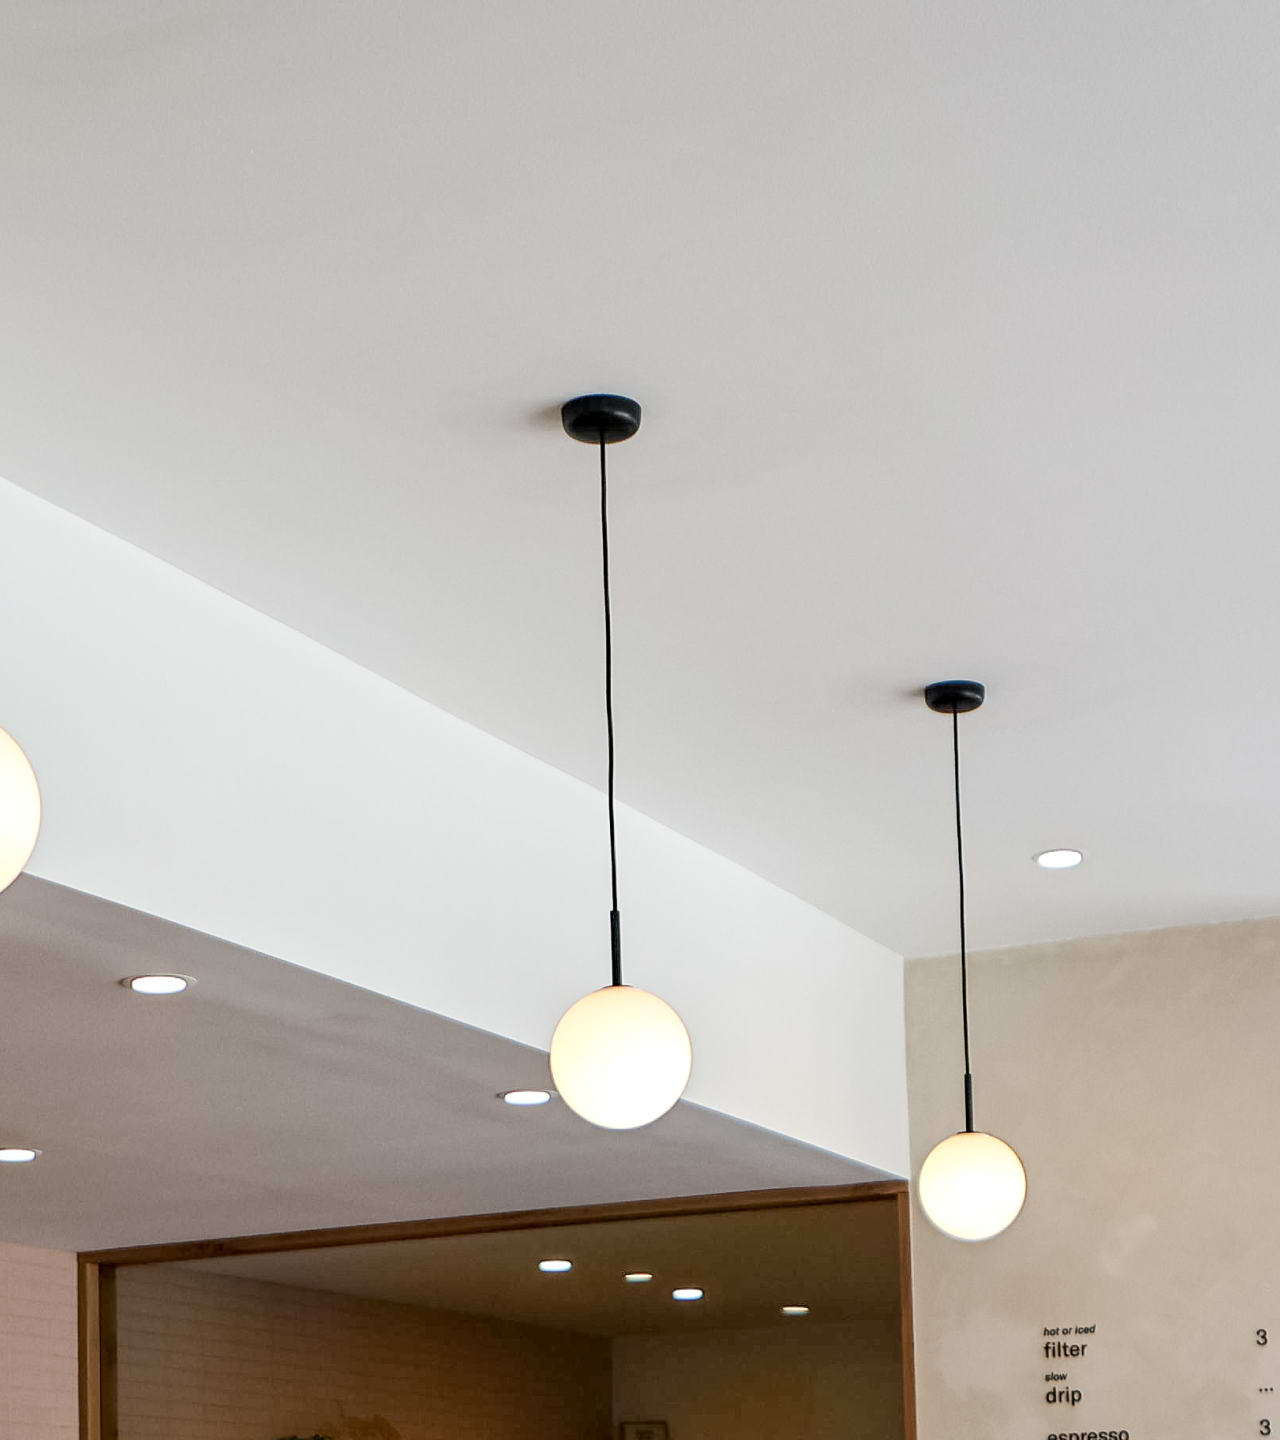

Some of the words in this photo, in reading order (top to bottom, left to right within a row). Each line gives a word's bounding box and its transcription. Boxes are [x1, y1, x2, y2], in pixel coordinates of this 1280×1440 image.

[1043, 1326, 1060, 1337] hot
[1061, 1327, 1073, 1336] or
[1074, 1324, 1097, 1335] iced
[1256, 1328, 1268, 1347] 3
[1043, 1341, 1088, 1359] filter
[1044, 1371, 1068, 1382] slow
[1045, 1386, 1082, 1407] drip
[1259, 1418, 1272, 1437] 3
